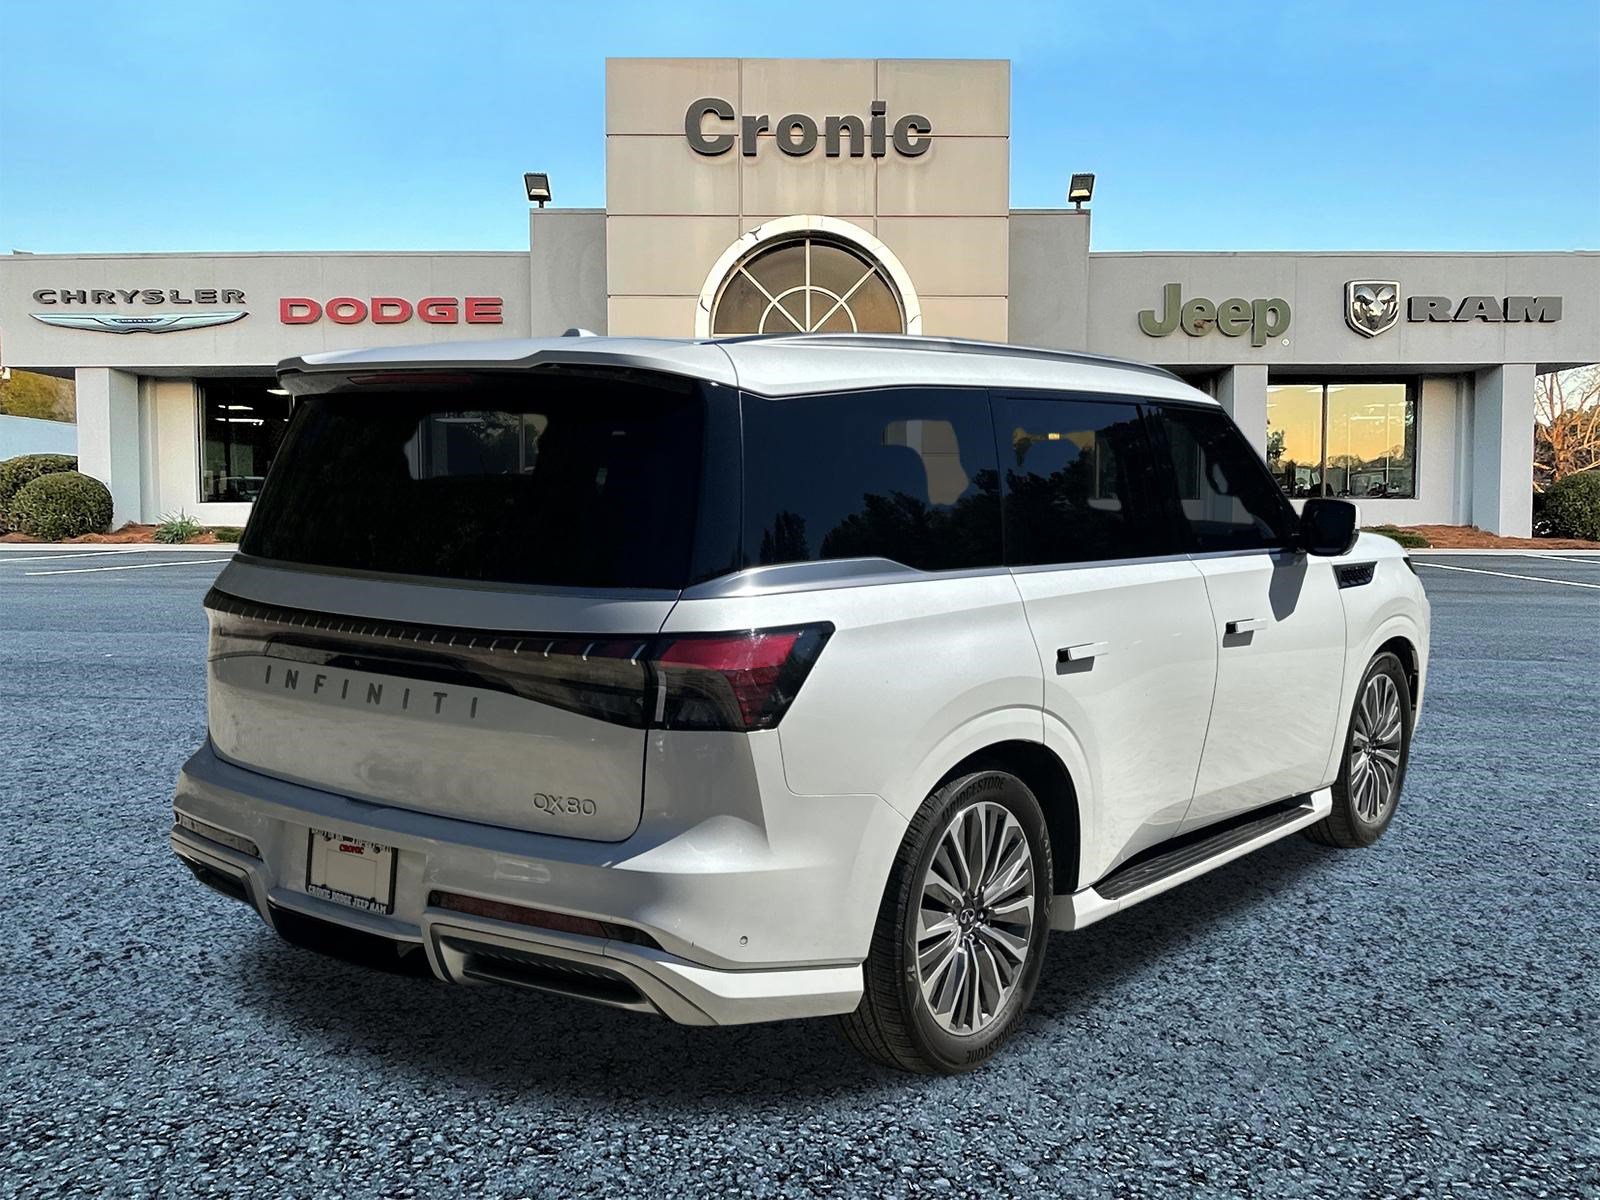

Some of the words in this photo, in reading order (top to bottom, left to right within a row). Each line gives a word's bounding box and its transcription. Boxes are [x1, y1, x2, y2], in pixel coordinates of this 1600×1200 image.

[684, 97, 932, 157] Cronic
[32, 288, 247, 305] CHRYSLER
[1407, 296, 1563, 322] RAM
[279, 297, 504, 325] DODGE
[1138, 283, 1292, 347] Jeep
[264, 664, 478, 719] INFINITI
[533, 792, 597, 816] QX80
